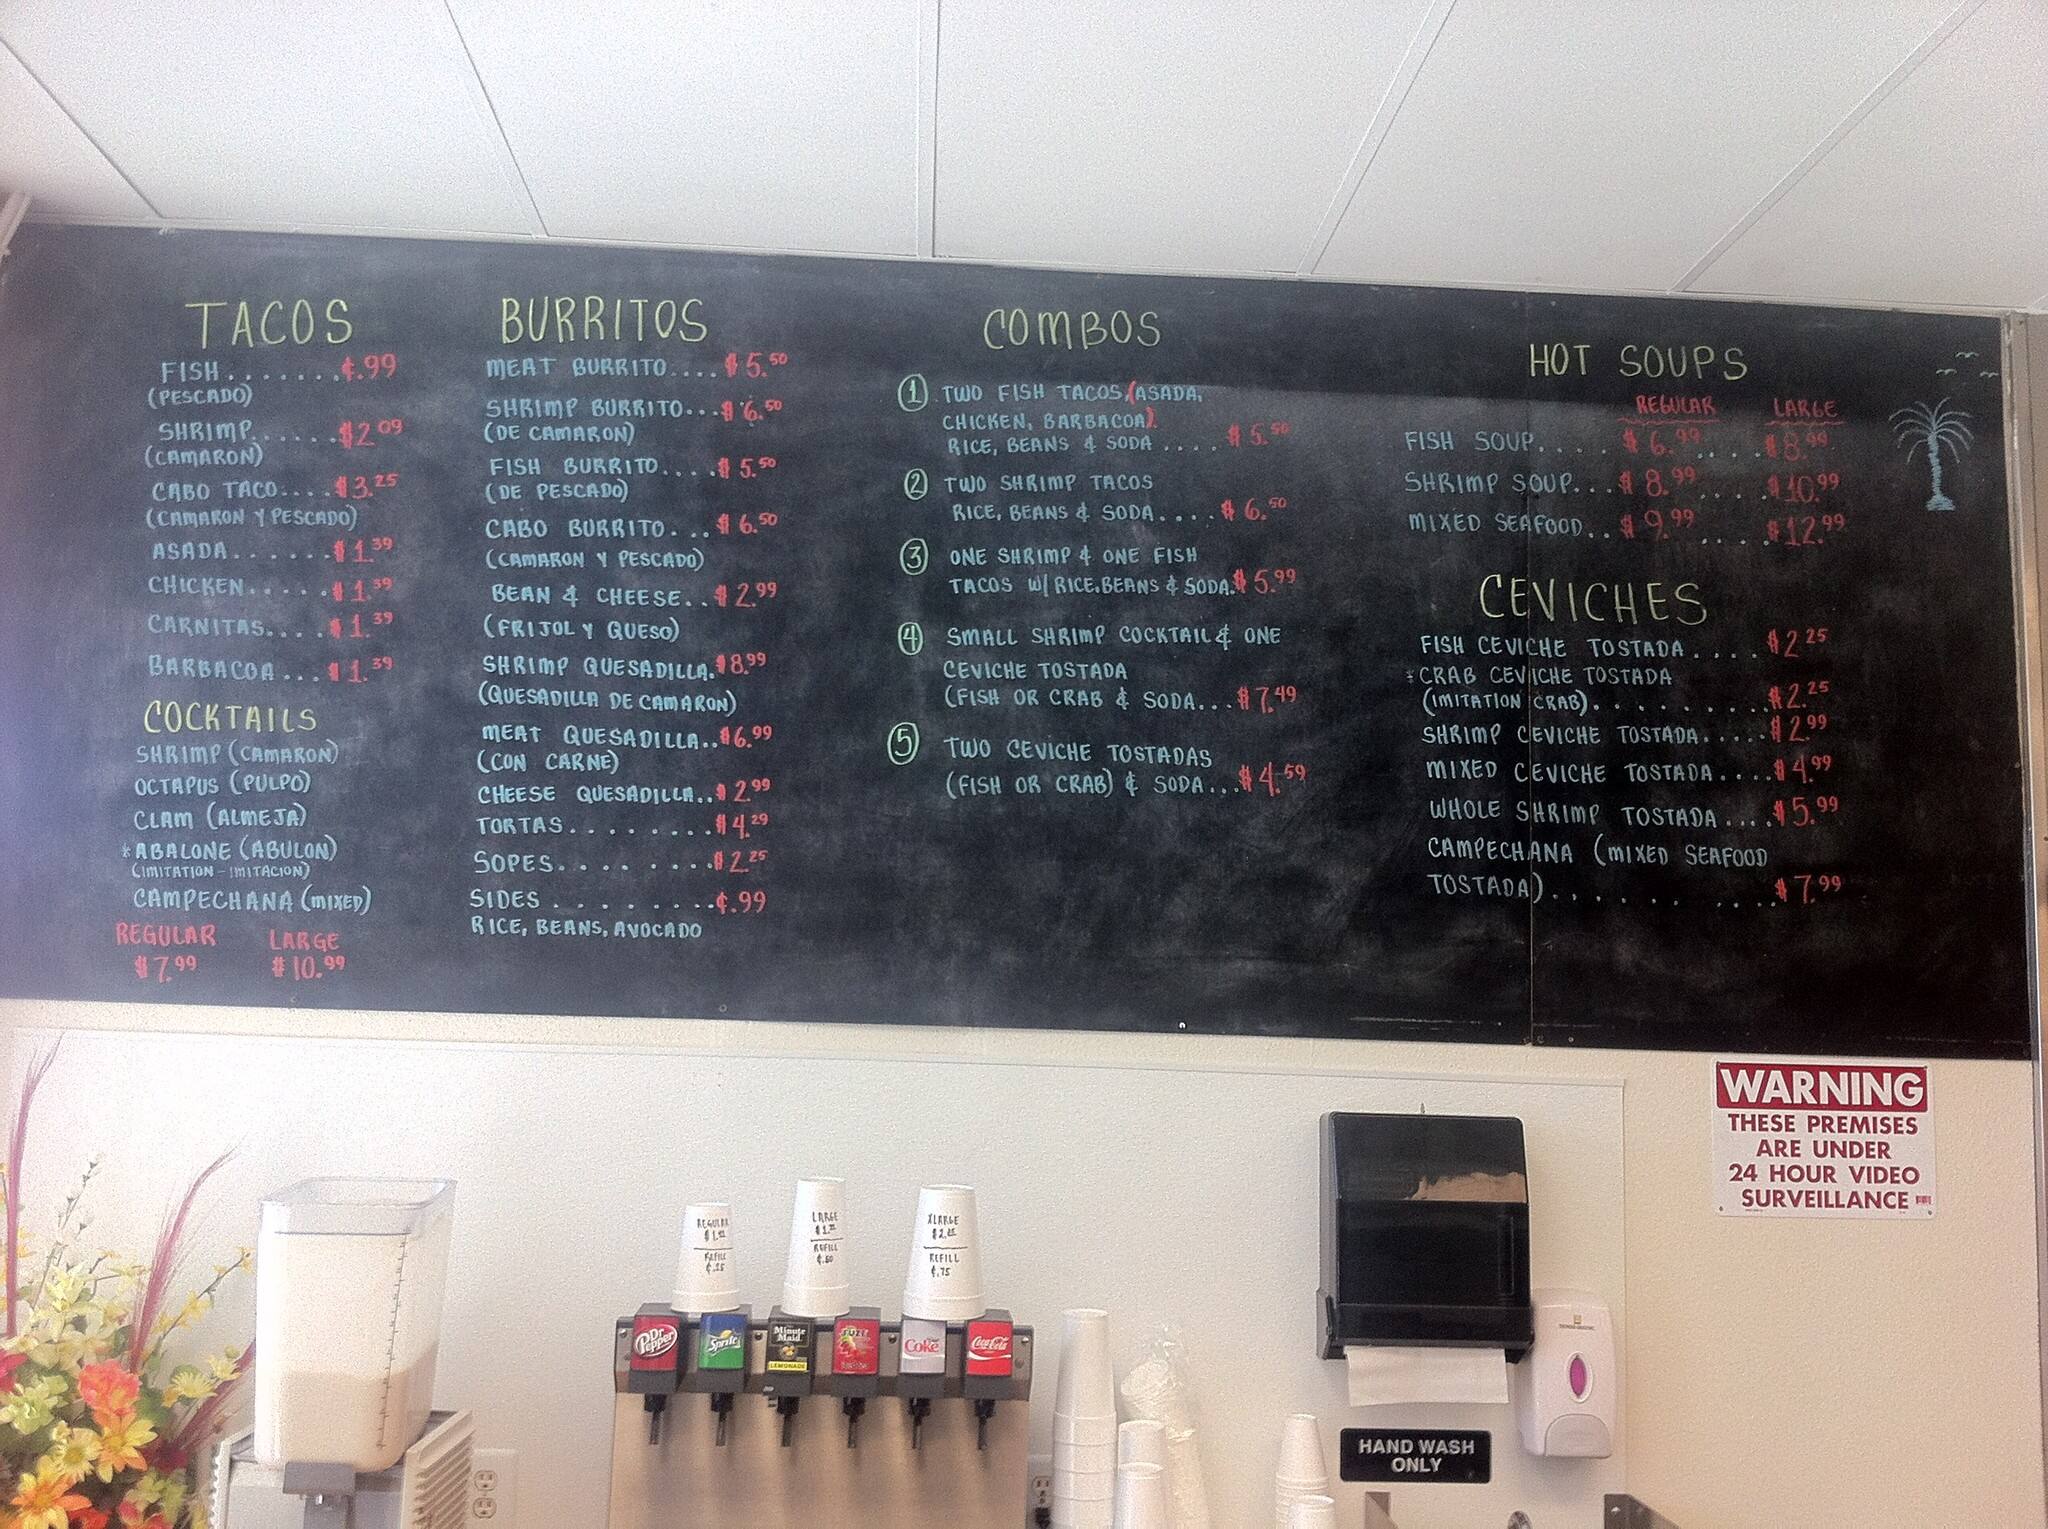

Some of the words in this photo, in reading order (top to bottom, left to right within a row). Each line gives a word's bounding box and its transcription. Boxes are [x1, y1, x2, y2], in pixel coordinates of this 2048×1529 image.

[185, 299, 353, 349] TACOS
[502, 296, 708, 344] BURRITOS
[983, 309, 1161, 349] COMBOS
[487, 358, 556, 380] MEAT
[1529, 343, 1591, 377] HOT
[1620, 344, 1748, 380] SOUPS
[148, 383, 253, 409] (PESCADO)
[942, 385, 983, 402] TWO
[999, 384, 1045, 402] FISH
[485, 398, 579, 419] SHRIMP
[1635, 395, 1717, 417] REGULAR
[1774, 399, 1838, 418] LARGE
[943, 412, 1033, 431] CHICKEN,
[484, 422, 520, 444] (DE
[529, 421, 635, 446] CAMARON)
[1405, 431, 1454, 451] FISH
[145, 443, 263, 468] (CAMARON)
[948, 437, 998, 457] RICE,
[1008, 436, 1070, 453] BEANS
[490, 458, 541, 476] FISH
[152, 483, 210, 501] CABO
[485, 484, 522, 504] (DE
[537, 479, 628, 503] PESCADO)
[945, 475, 987, 494] TWO
[1000, 474, 1077, 492] SHRIMP
[1090, 474, 1154, 491] TACOS
[1404, 472, 1500, 494] SHRIMP
[146, 508, 245, 529] (CAMARON
[256, 510, 265, 527] Y
[271, 505, 358, 531] PESCADO)
[1010, 504, 1069, 522] BEANS
[1409, 512, 1481, 532] MIXED
[485, 518, 548, 538] CABO
[486, 549, 585, 569] (CAMARON
[597, 552, 608, 567] Y
[619, 547, 704, 572] PESCADO)
[950, 547, 987, 567] ONE
[998, 546, 1072, 565] SHRIMP
[1103, 547, 1140, 565] ONE
[1154, 546, 1197, 564] FISH
[492, 584, 550, 604] BEAN
[949, 577, 1013, 595] TACOS
[1480, 574, 1708, 625] CEVICHES
[484, 613, 576, 639] (FRIJOL
[582, 622, 593, 640] Y
[608, 616, 680, 642] QUESO)
[947, 627, 1018, 647] SMALL
[1032, 625, 1106, 644] SHRIMP
[1119, 626, 1211, 645] COCKTAIL
[1244, 627, 1282, 645] ONE
[1420, 635, 1464, 654] FISH
[1478, 636, 1567, 657] CEVICHE
[482, 655, 568, 675] SHRIMP
[944, 661, 1027, 680] CEVICHE
[1038, 661, 1128, 680] TOSTADA
[1490, 666, 1573, 685] CEVICHE
[1582, 667, 1672, 686] TOSTADA
[478, 680, 599, 707] (QUESADILLA
[609, 692, 633, 710] DE
[639, 690, 737, 717] CAMARON)
[945, 685, 1000, 708] (FISH
[1015, 690, 1039, 706] OR
[1049, 688, 1102, 707] CRAB
[1422, 688, 1521, 716] (IMITATION
[144, 700, 317, 733] COCKTAILS
[482, 724, 542, 743] MEAT
[1422, 725, 1501, 745] SHRIMP
[1517, 726, 1600, 745] CEVICHE
[137, 743, 221, 764] SHRIMP
[229, 739, 339, 766] (CAMARON)
[477, 750, 527, 774] (CON
[546, 750, 619, 774] CARNE)
[944, 736, 991, 760] TWO
[1007, 739, 1091, 762] CEVICHE
[1107, 744, 1213, 768] TOSTADAS
[1426, 760, 1498, 780] MIXED
[1514, 762, 1607, 783] CEVICHE
[135, 776, 219, 796] OCTAPUS
[230, 770, 312, 795] (PULPO)
[946, 771, 1001, 800] (FISH
[1015, 776, 1041, 794] OR
[1056, 768, 1113, 798] CRAB)
[478, 785, 556, 805] CHEESE
[134, 811, 193, 830] CLAM
[207, 801, 307, 829] (ALMEJA)
[1429, 797, 1501, 820] WHOLE
[1516, 801, 1600, 824] SHRIMP
[240, 834, 337, 861] (ABULON)
[1428, 836, 1573, 864] CAMPECHANA
[1594, 833, 1669, 866] (MIXED
[1685, 844, 1768, 868] SEAFOOD
[131, 863, 214, 878] (IMITATION
[229, 862, 310, 879] IMITACION)
[134, 888, 293, 912] CAMPECHANA
[301, 884, 372, 915] (MIXED)
[116, 921, 218, 946] REGULAR
[269, 929, 340, 952] LARGE
[471, 916, 527, 937] RICE,
[536, 918, 609, 938] BEANS,
[614, 921, 702, 939] AVOCADO
[1720, 1069, 1924, 1107] WARNING
[1728, 1114, 1796, 1132] THESE
[1807, 1115, 1918, 1135] PREMISES
[1756, 1140, 1801, 1157] ARE
[1813, 1141, 1891, 1159] UNDER
[1729, 1164, 1758, 1182] 24
[1770, 1165, 1837, 1183] HOUR
[1849, 1166, 1920, 1185] VIDEO
[1742, 1189, 1909, 1209] SURVEILLANCE
[812, 1211, 839, 1223] LARGE
[930, 1253, 960, 1263] REFILL
[650, 1328, 664, 1340] Dr
[774, 1326, 806, 1335] Minute
[778, 1334, 800, 1342] Maid
[639, 1331, 674, 1354] Pepper
[709, 1336, 738, 1351] Sprite
[905, 1339, 939, 1353] Coke
[1359, 1439, 1414, 1455] HAND
[1418, 1440, 1474, 1455] WASH
[1390, 1457, 1442, 1473] ONLY
